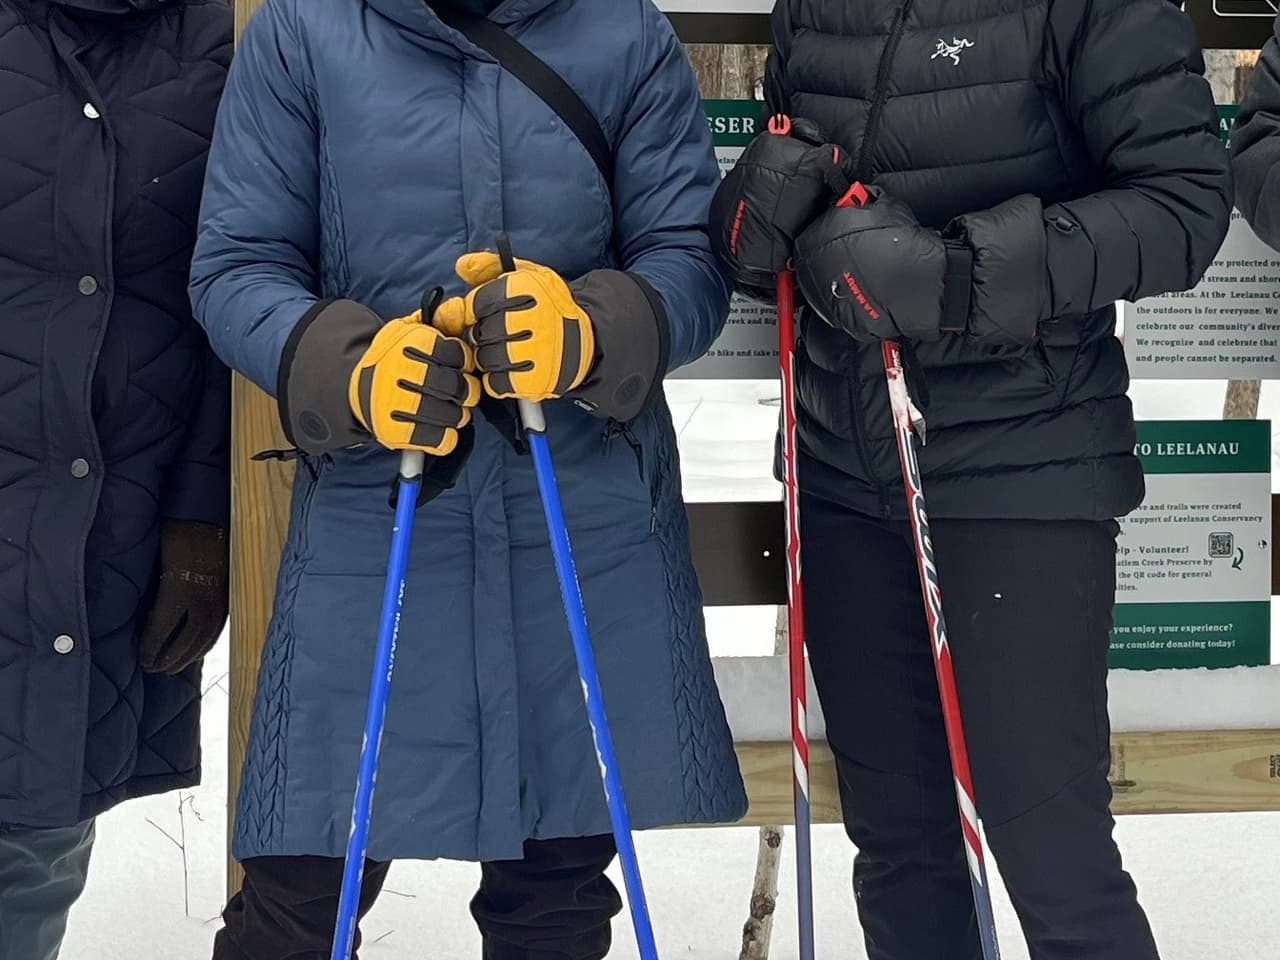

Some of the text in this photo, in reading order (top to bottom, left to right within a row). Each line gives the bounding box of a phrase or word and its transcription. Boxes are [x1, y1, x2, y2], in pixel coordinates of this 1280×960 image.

[1226, 260, 1268, 269] protected
[1240, 274, 1256, 283] and
[1212, 291, 1226, 299] the
[1231, 291, 1270, 299] Leelanau
[1198, 323, 1255, 331] community's
[1151, 339, 1194, 348] recognize
[717, 349, 735, 357] hike
[737, 349, 752, 357] and
[1136, 354, 1152, 362] and
[1154, 354, 1184, 364] people
[1186, 354, 1217, 362] cannot
[1157, 442, 1239, 456] LEELANAU
[1150, 503, 1165, 511] and
[1167, 503, 1188, 511] trails
[1211, 503, 1242, 511] created
[1173, 515, 1210, 523] Leelanau
[1212, 514, 1263, 523] Conservancy
[1203, 558, 1214, 566] by
[1181, 570, 1212, 579] general
[1132, 625, 1156, 635] enjoy
[1158, 626, 1179, 634] your
[1180, 623, 1234, 634] experience?
[1126, 640, 1165, 649] consider
[1166, 640, 1206, 649] donating
[1207, 640, 1237, 648] today!
